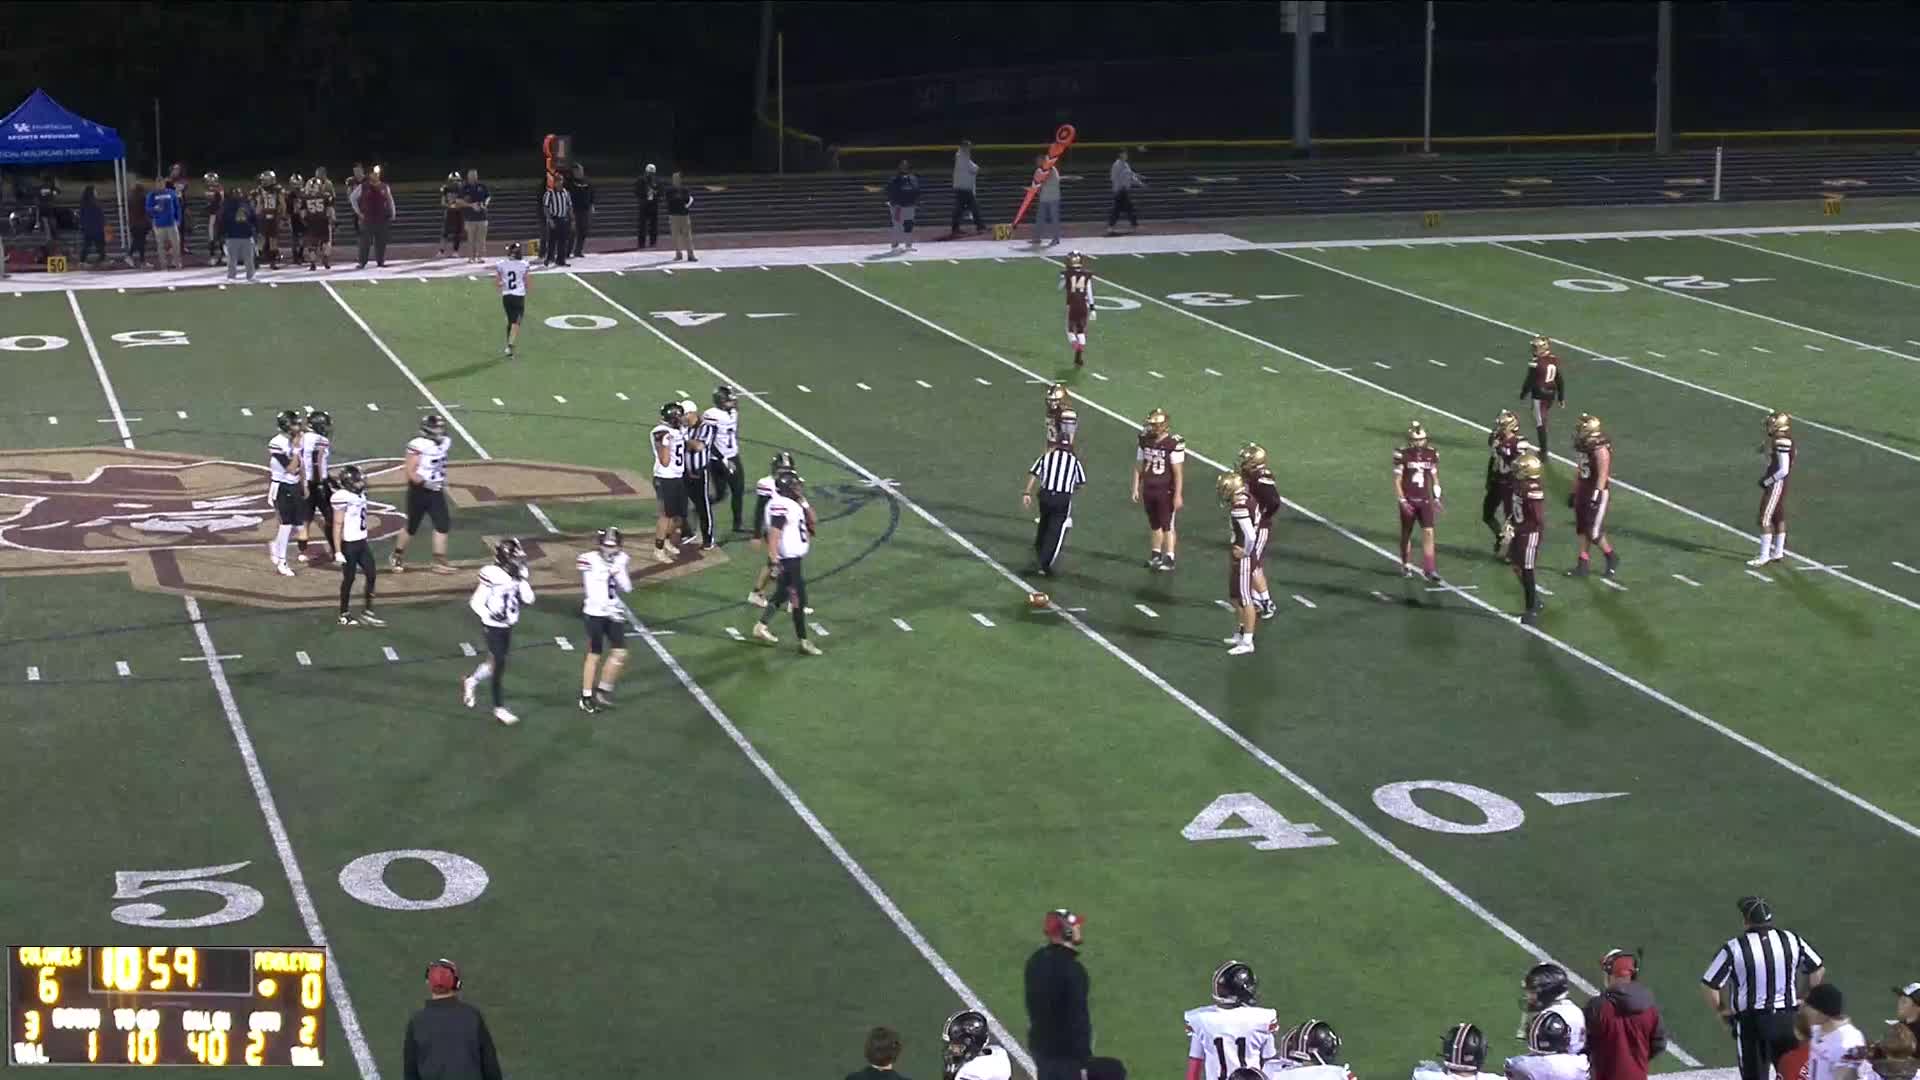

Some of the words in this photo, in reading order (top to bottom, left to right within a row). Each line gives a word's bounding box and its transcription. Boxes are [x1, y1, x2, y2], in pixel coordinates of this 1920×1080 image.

[49, 258, 66, 273] 50
[507, 270, 517, 290] 2
[1070, 275, 1086, 293] 14
[675, 443, 684, 466] 5
[1411, 466, 1425, 488] 4
[1213, 1036, 1248, 1080] 11
